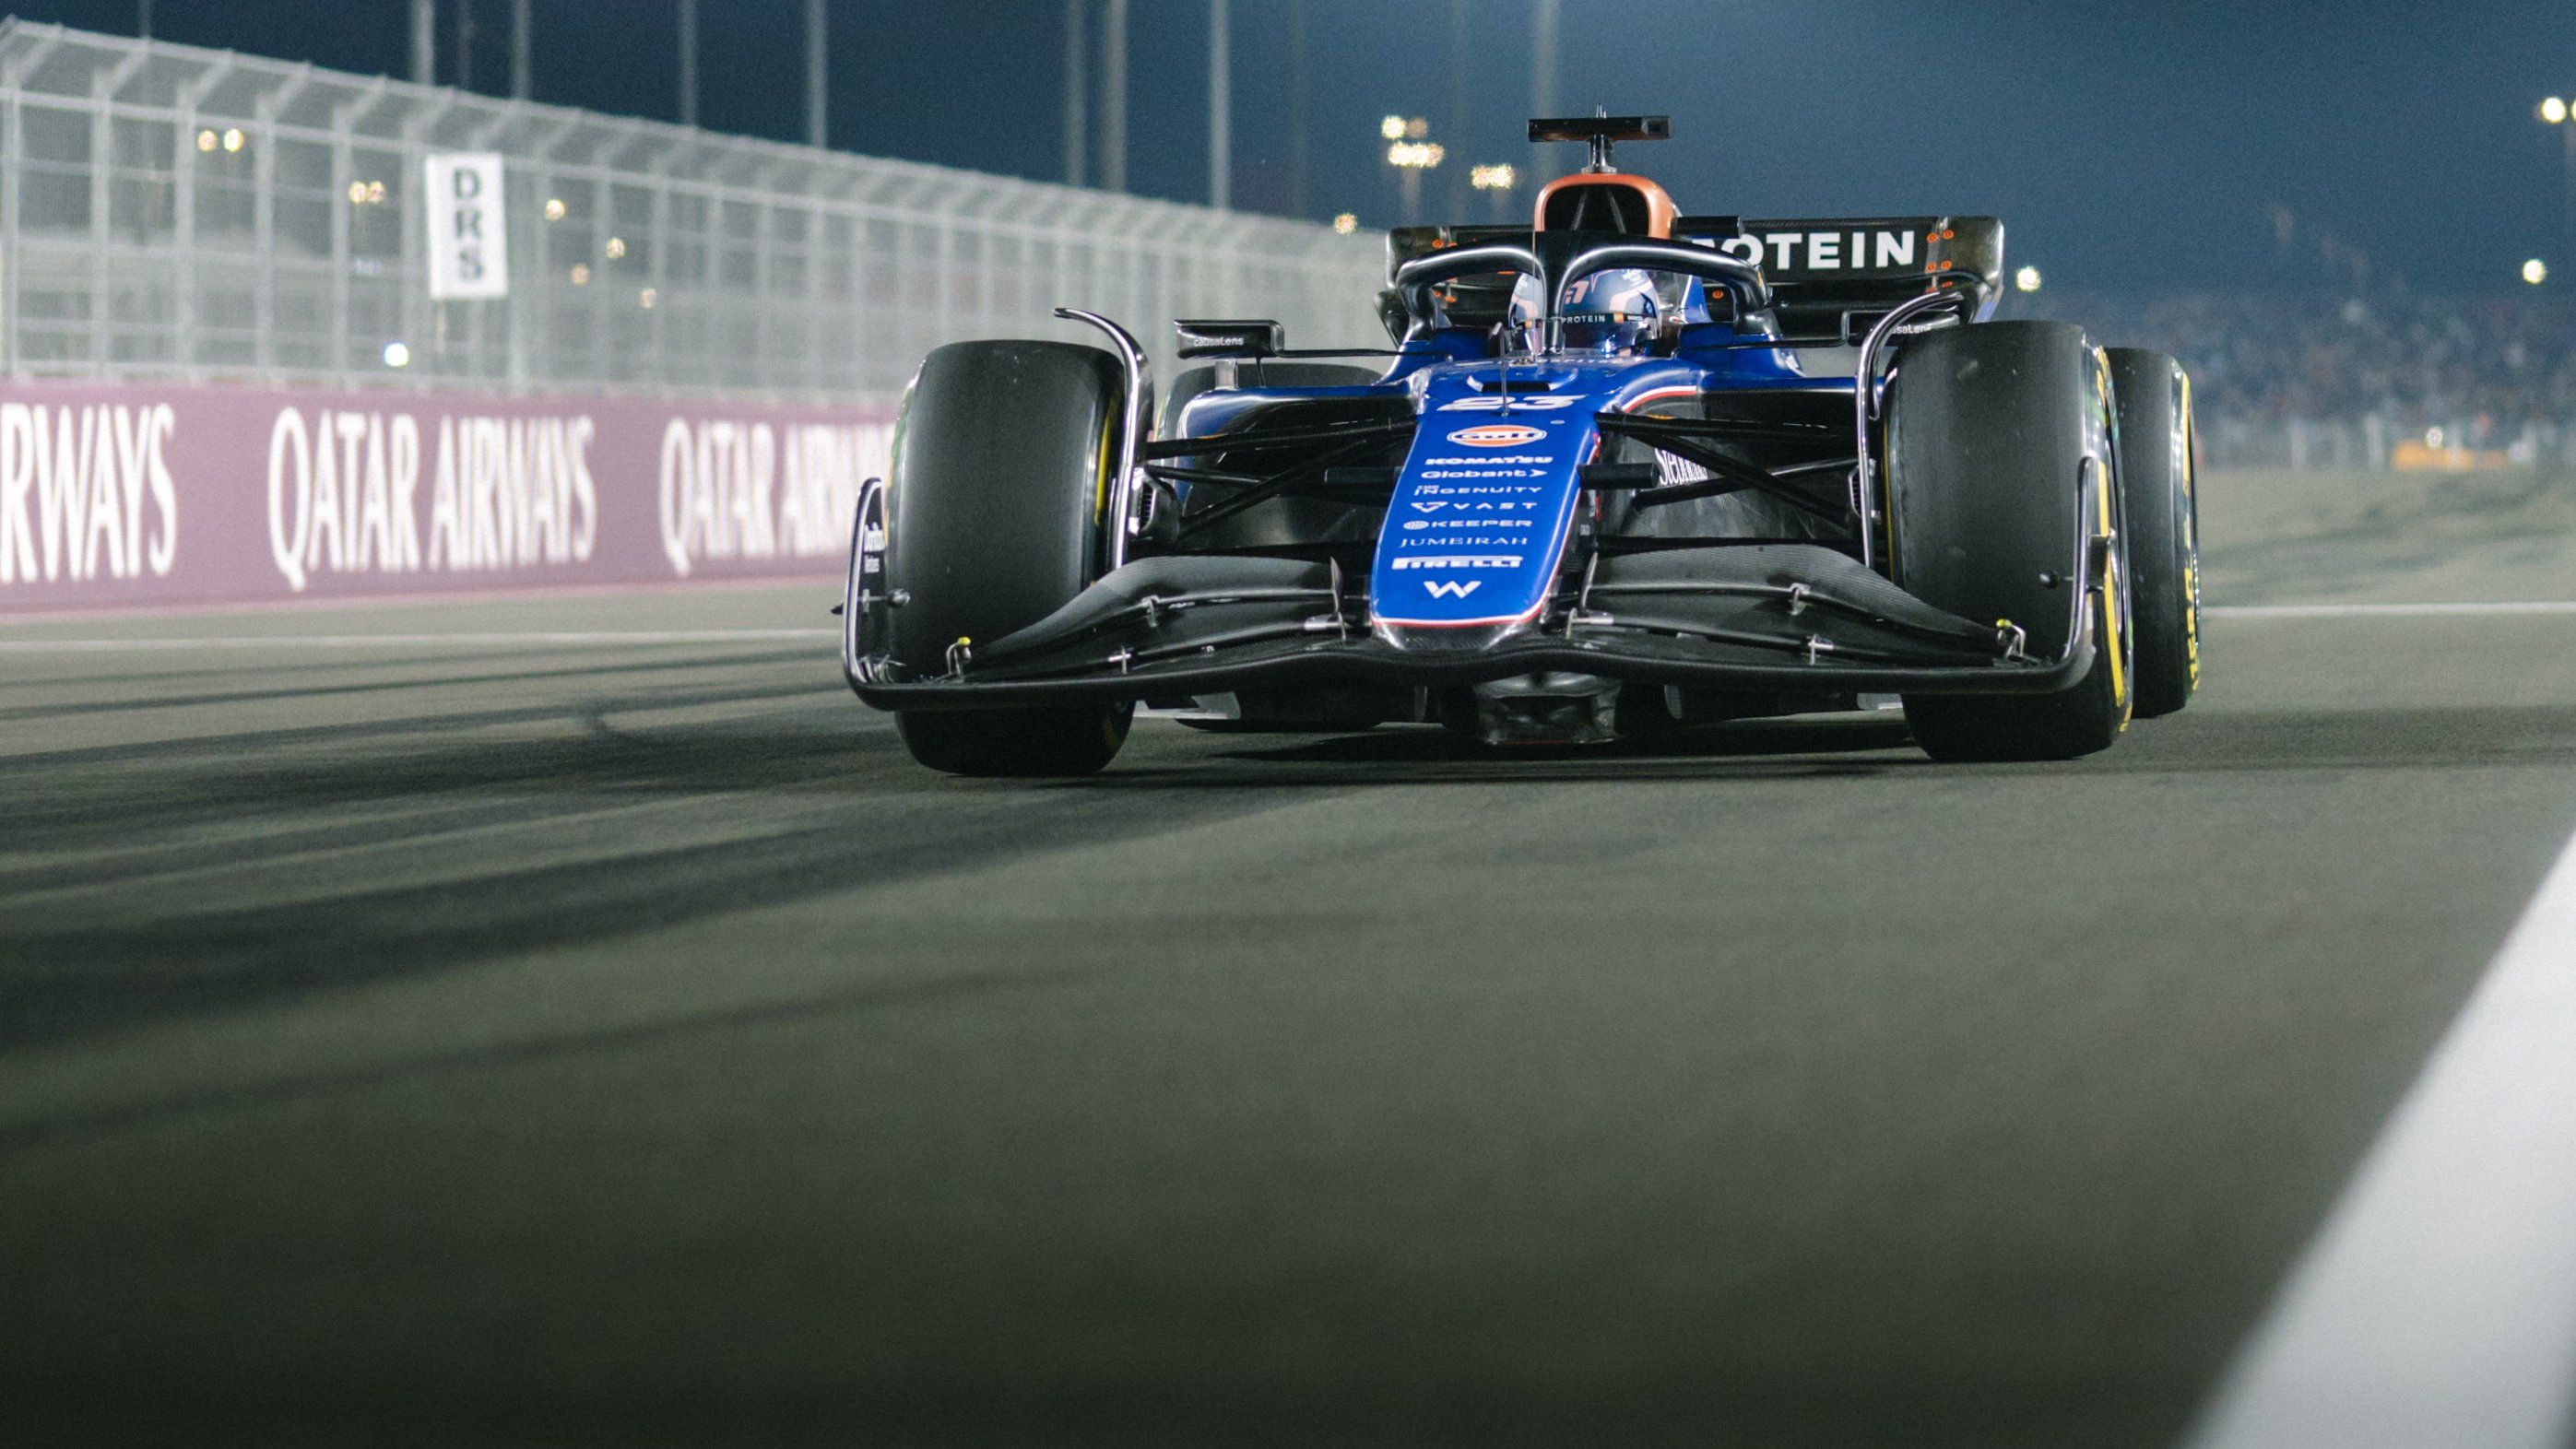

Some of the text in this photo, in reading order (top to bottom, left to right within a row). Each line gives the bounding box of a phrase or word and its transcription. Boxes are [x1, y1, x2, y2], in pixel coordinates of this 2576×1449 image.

[454, 168, 483, 280] DRS
[1693, 230, 1915, 270] OTEIN
[1436, 394, 1590, 411] 23
[1424, 455, 1554, 465] KOMATSU
[0, 403, 177, 583] RWAYS
[267, 406, 597, 591] QATAR AIRWAYS
[659, 418, 776, 577] QATAR
[1453, 501, 1538, 510] VAST
[1431, 519, 1533, 528] KEEPER
[1399, 536, 1528, 548] JUMEIRAH
[1391, 555, 1523, 570] PIRELLI
